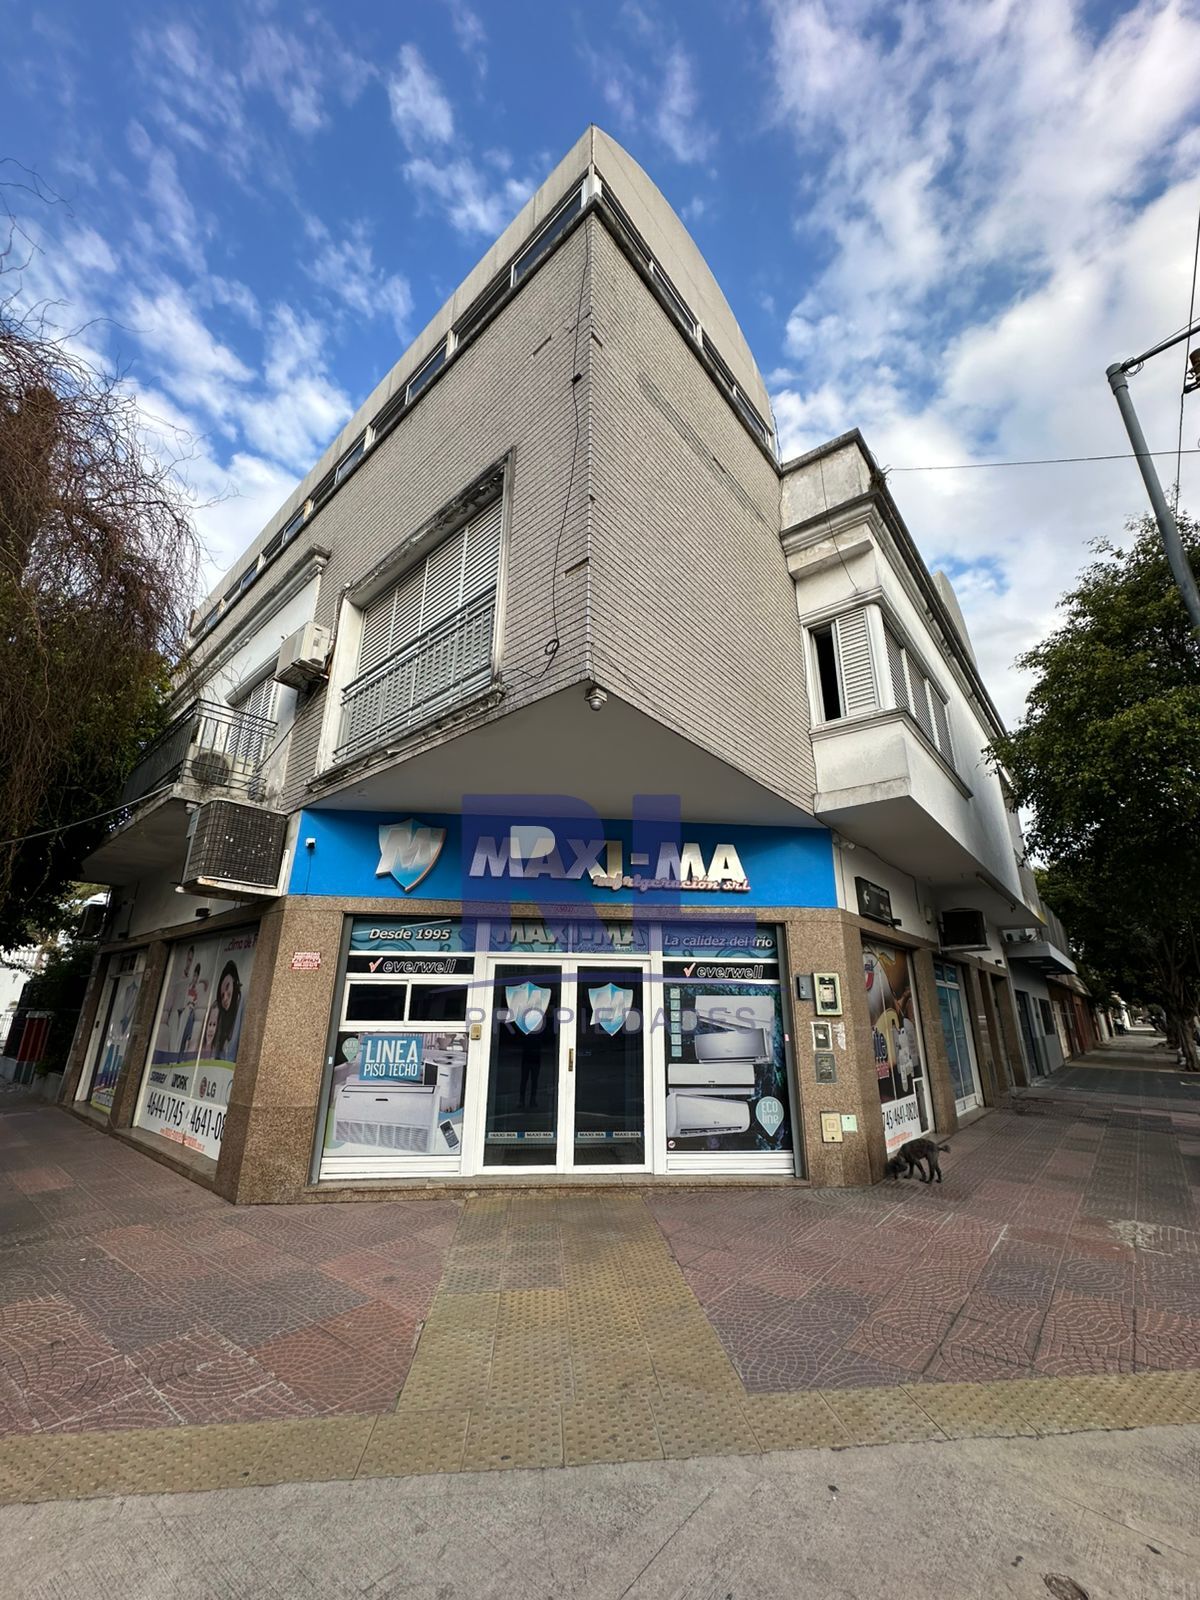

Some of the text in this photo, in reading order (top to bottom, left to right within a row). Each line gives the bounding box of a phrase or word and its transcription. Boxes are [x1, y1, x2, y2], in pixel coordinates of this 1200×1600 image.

[469, 836, 746, 882] MAXI-MA
[369, 928, 450, 940] Desde 1995
[664, 935, 679, 946] La
[682, 935, 725, 947] calidez
[729, 936, 748, 947] del
[382, 958, 457, 974] everwell
[696, 964, 764, 979] everwell
[365, 1040, 418, 1063] LINEA
[364, 1063, 418, 1077] PISO TECHO
[206, 1080, 217, 1098] LG
[761, 1101, 778, 1113] ECO
[762, 1112, 779, 1124] line
